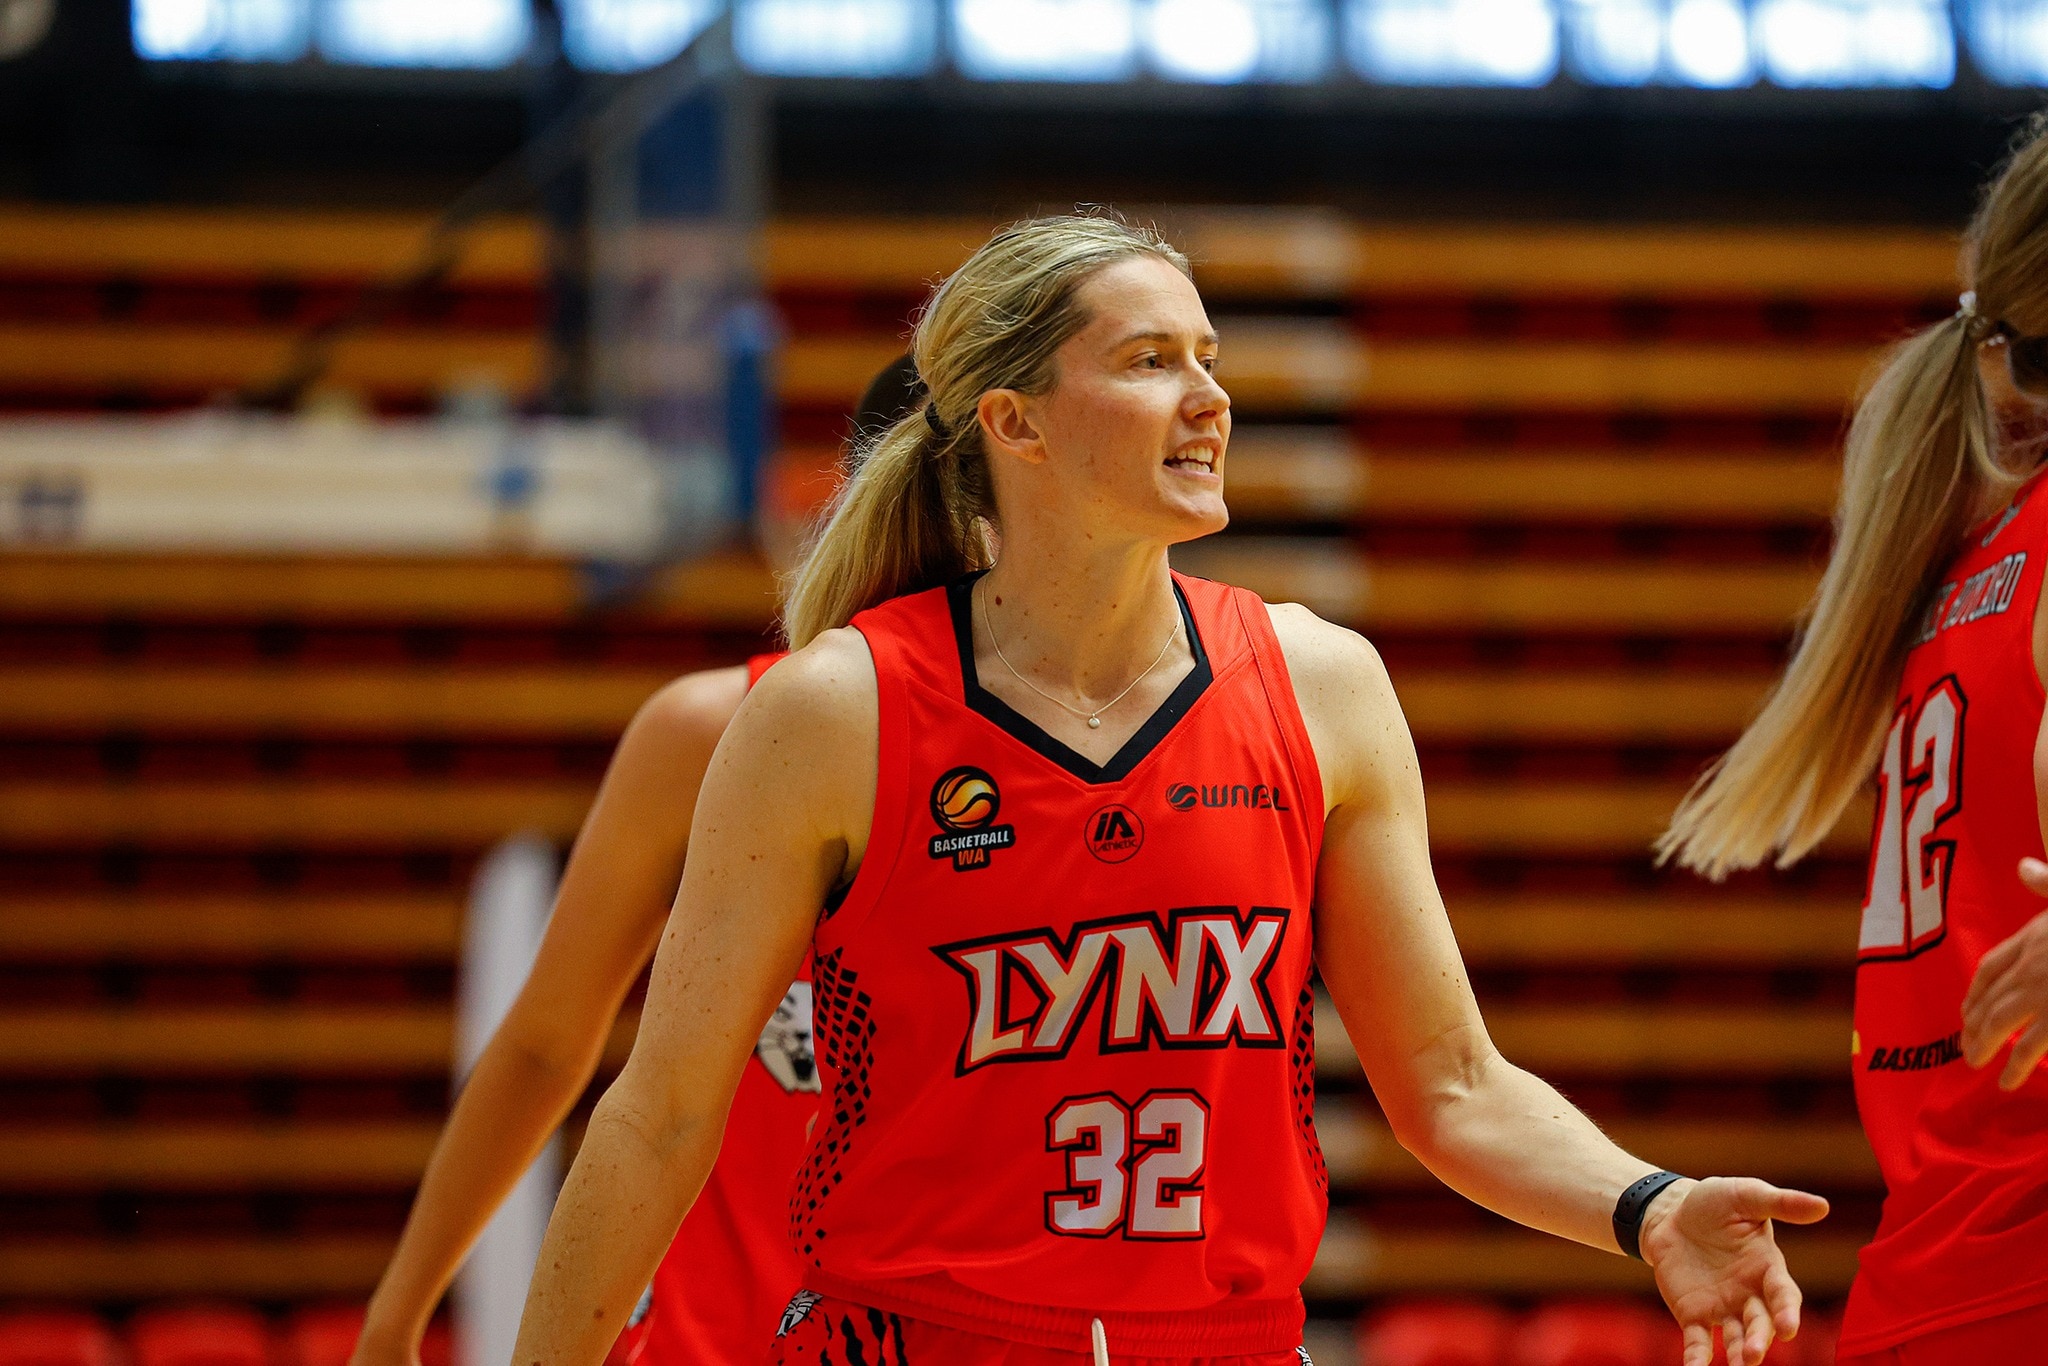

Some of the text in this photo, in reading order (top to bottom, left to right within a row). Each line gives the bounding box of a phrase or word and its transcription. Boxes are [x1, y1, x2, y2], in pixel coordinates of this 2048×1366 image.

[934, 830, 1009, 853] BASKETBALL
[1201, 784, 1290, 811] WNBL
[1858, 675, 1967, 964] 12
[958, 848, 984, 866] WA
[932, 906, 1289, 1076] LYNX
[1045, 1089, 1210, 1241] 32
